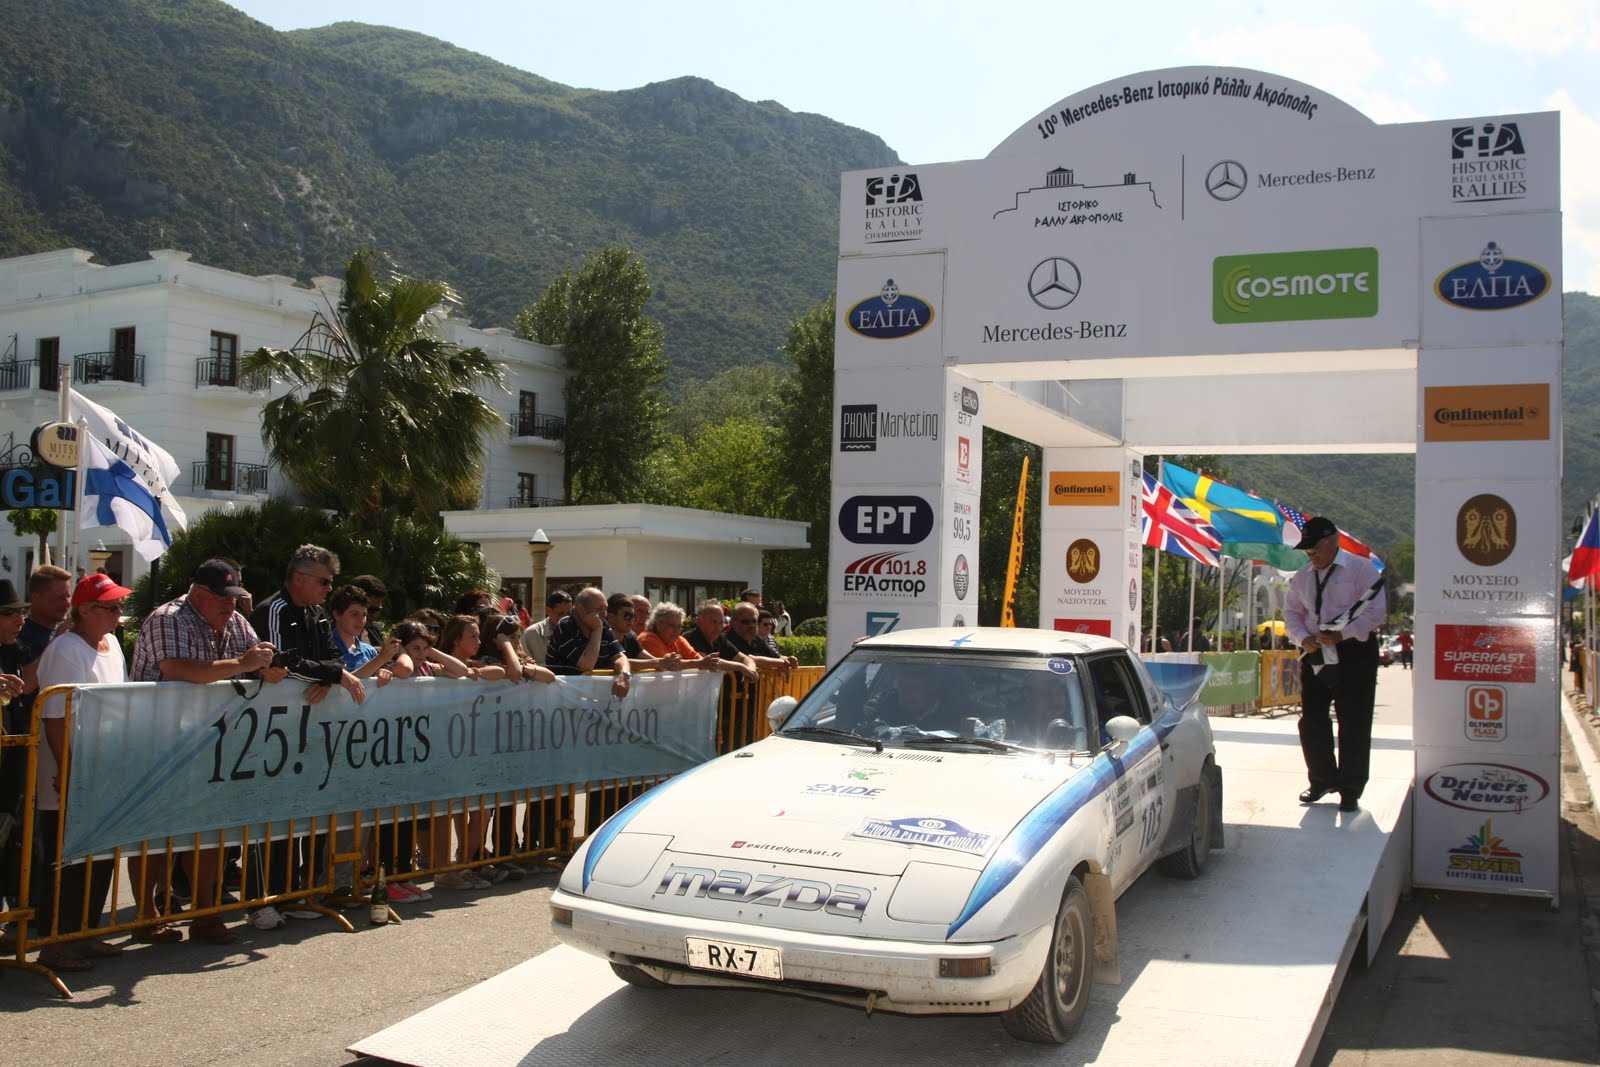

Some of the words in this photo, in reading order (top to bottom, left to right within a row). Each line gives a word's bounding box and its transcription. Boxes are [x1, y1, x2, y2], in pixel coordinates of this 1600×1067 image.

[1060, 86, 1154, 128] Mercedes-Benz
[1158, 77, 1210, 100] Ιστορικό
[1452, 157, 1527, 174] HISTORIC
[1257, 166, 1376, 188] Mercedes-Benz
[1452, 171, 1526, 184] REGULARITY
[1452, 180, 1527, 198] RALLIES
[866, 204, 923, 219] HISTORIC
[865, 217, 922, 230] RALLY
[864, 229, 923, 240] CHAMPIONSHIP
[1236, 271, 1370, 300] COSMOTE
[982, 321, 1128, 344] Mercedes-Benz
[1434, 406, 1524, 424] Continental
[842, 411, 876, 439] PHONE
[880, 411, 939, 441] Marketing
[4, 468, 75, 508] Gal
[1055, 484, 1106, 495] Continental
[885, 560, 927, 576] 101.8
[1452, 574, 1519, 586] ΜΟΥΣΕΙΟ
[1443, 651, 1526, 664] SUPERFAST
[1453, 663, 1513, 674] FERRIES
[1468, 721, 1503, 729] OLYMPUS
[1473, 728, 1498, 736] PLAZA
[208, 705, 311, 784] 125!
[318, 712, 432, 791] years
[447, 695, 485, 760] of
[493, 696, 661, 754] innovation
[806, 783, 887, 797] EXIDE
[1440, 775, 1528, 793] Drivers
[1452, 788, 1517, 804] News
[920, 820, 942, 829] 103
[746, 842, 843, 858] esittelyrekat.fi
